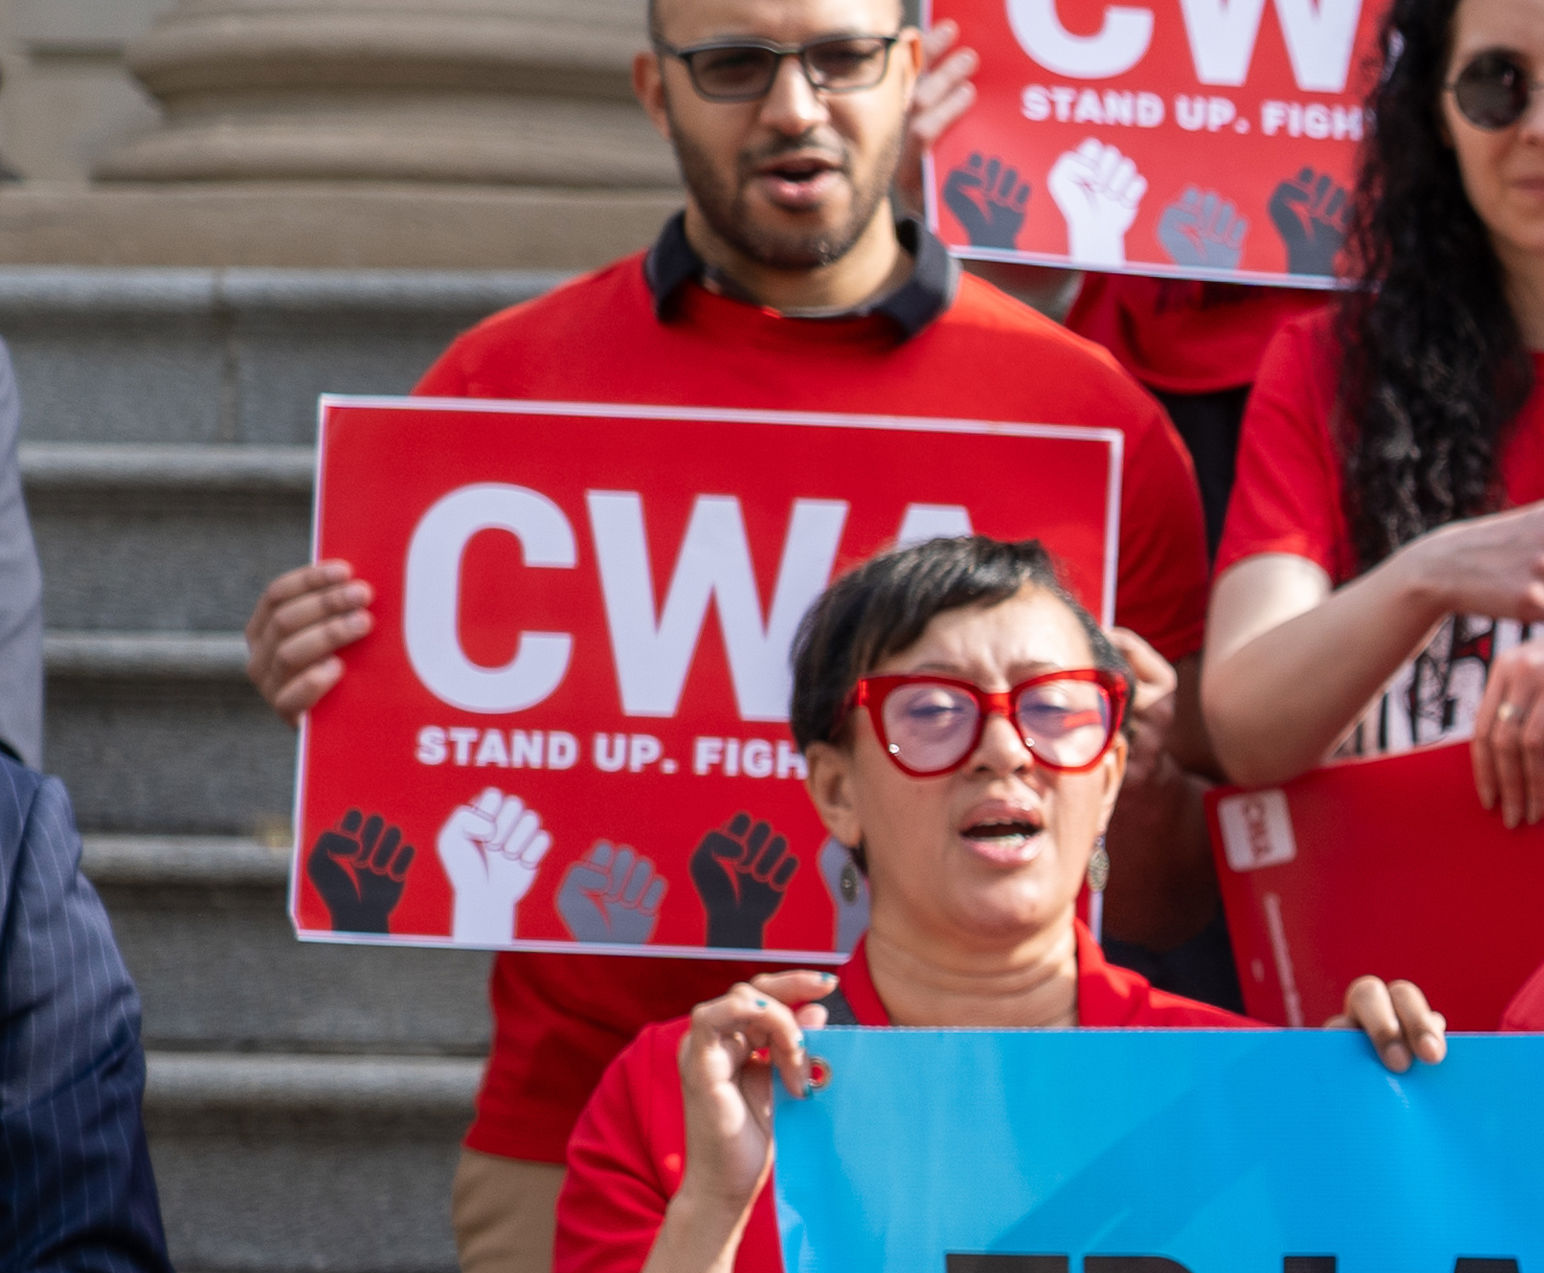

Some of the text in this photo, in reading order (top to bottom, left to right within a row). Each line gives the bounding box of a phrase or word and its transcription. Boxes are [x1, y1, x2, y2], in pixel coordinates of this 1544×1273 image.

[1021, 84, 1374, 142] STAND UP. FIGH
[404, 482, 986, 722] CW
[415, 725, 810, 781] STAND UP. FIGH
